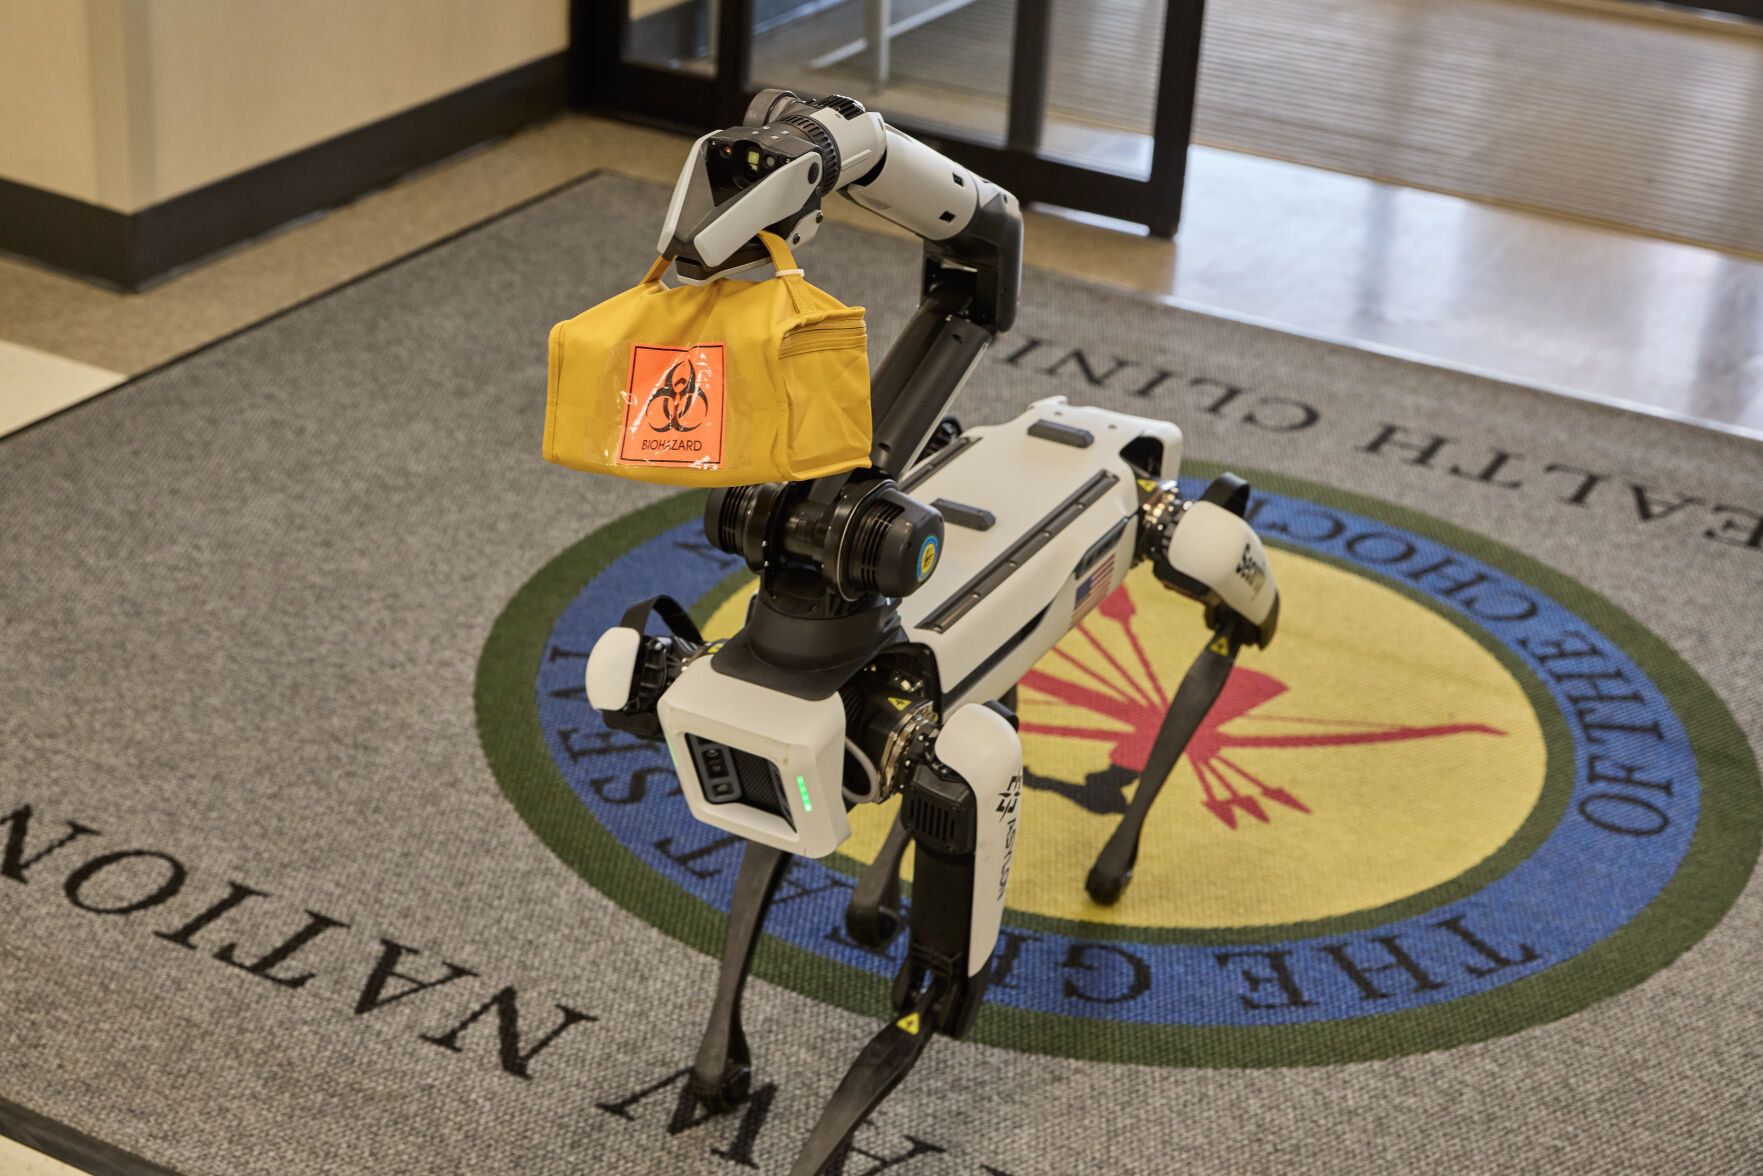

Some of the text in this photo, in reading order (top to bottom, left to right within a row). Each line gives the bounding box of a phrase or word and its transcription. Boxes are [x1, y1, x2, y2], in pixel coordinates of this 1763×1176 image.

[641, 439, 703, 452] BIOHAZARD
[994, 336, 1763, 549] EALTH CLINI
[1246, 498, 1675, 848] OF THE CHOC
[0, 804, 600, 1081] NATION
[1214, 914, 1541, 1010] THE
